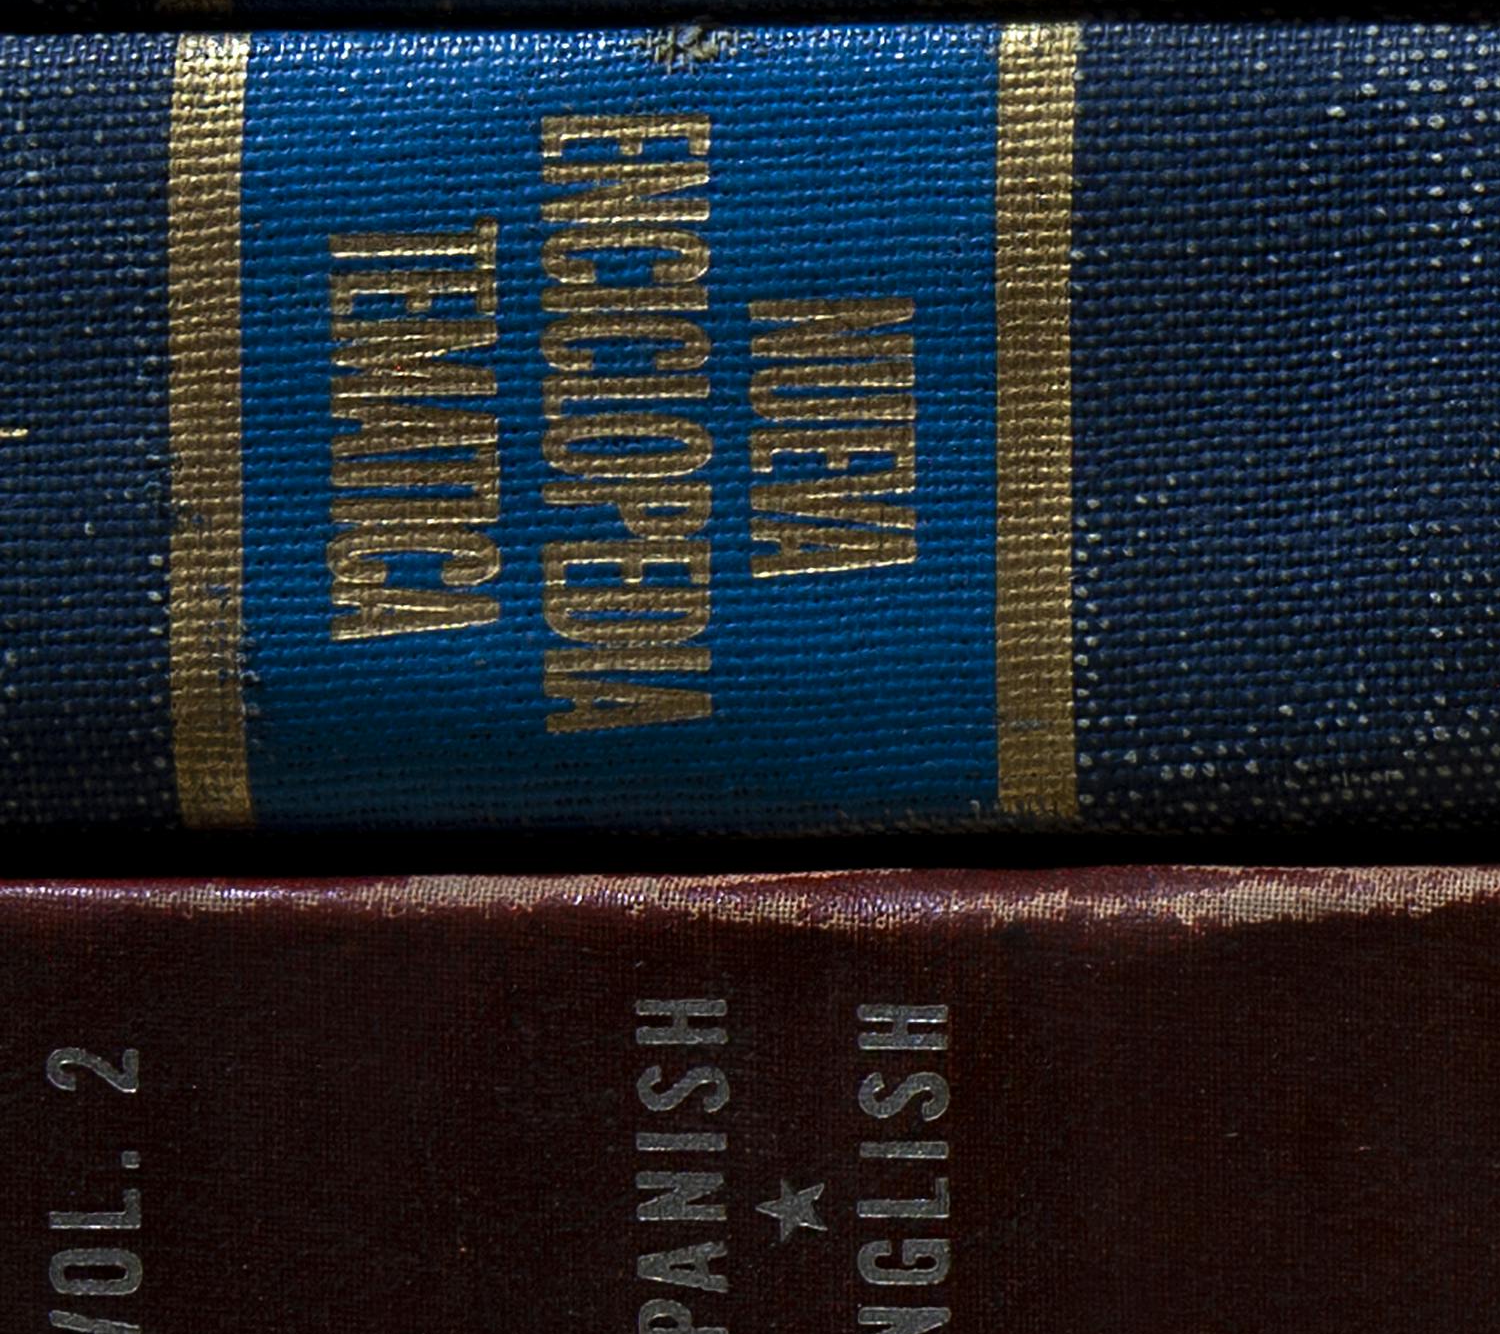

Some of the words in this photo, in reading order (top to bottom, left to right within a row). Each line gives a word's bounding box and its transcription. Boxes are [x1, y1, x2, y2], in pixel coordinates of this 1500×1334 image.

[328, 217, 500, 641] TEMATICA
[541, 114, 712, 734] ENCICLOPEDIA
[748, 297, 917, 578] NUEVA
[45, 1045, 140, 1094] 2
